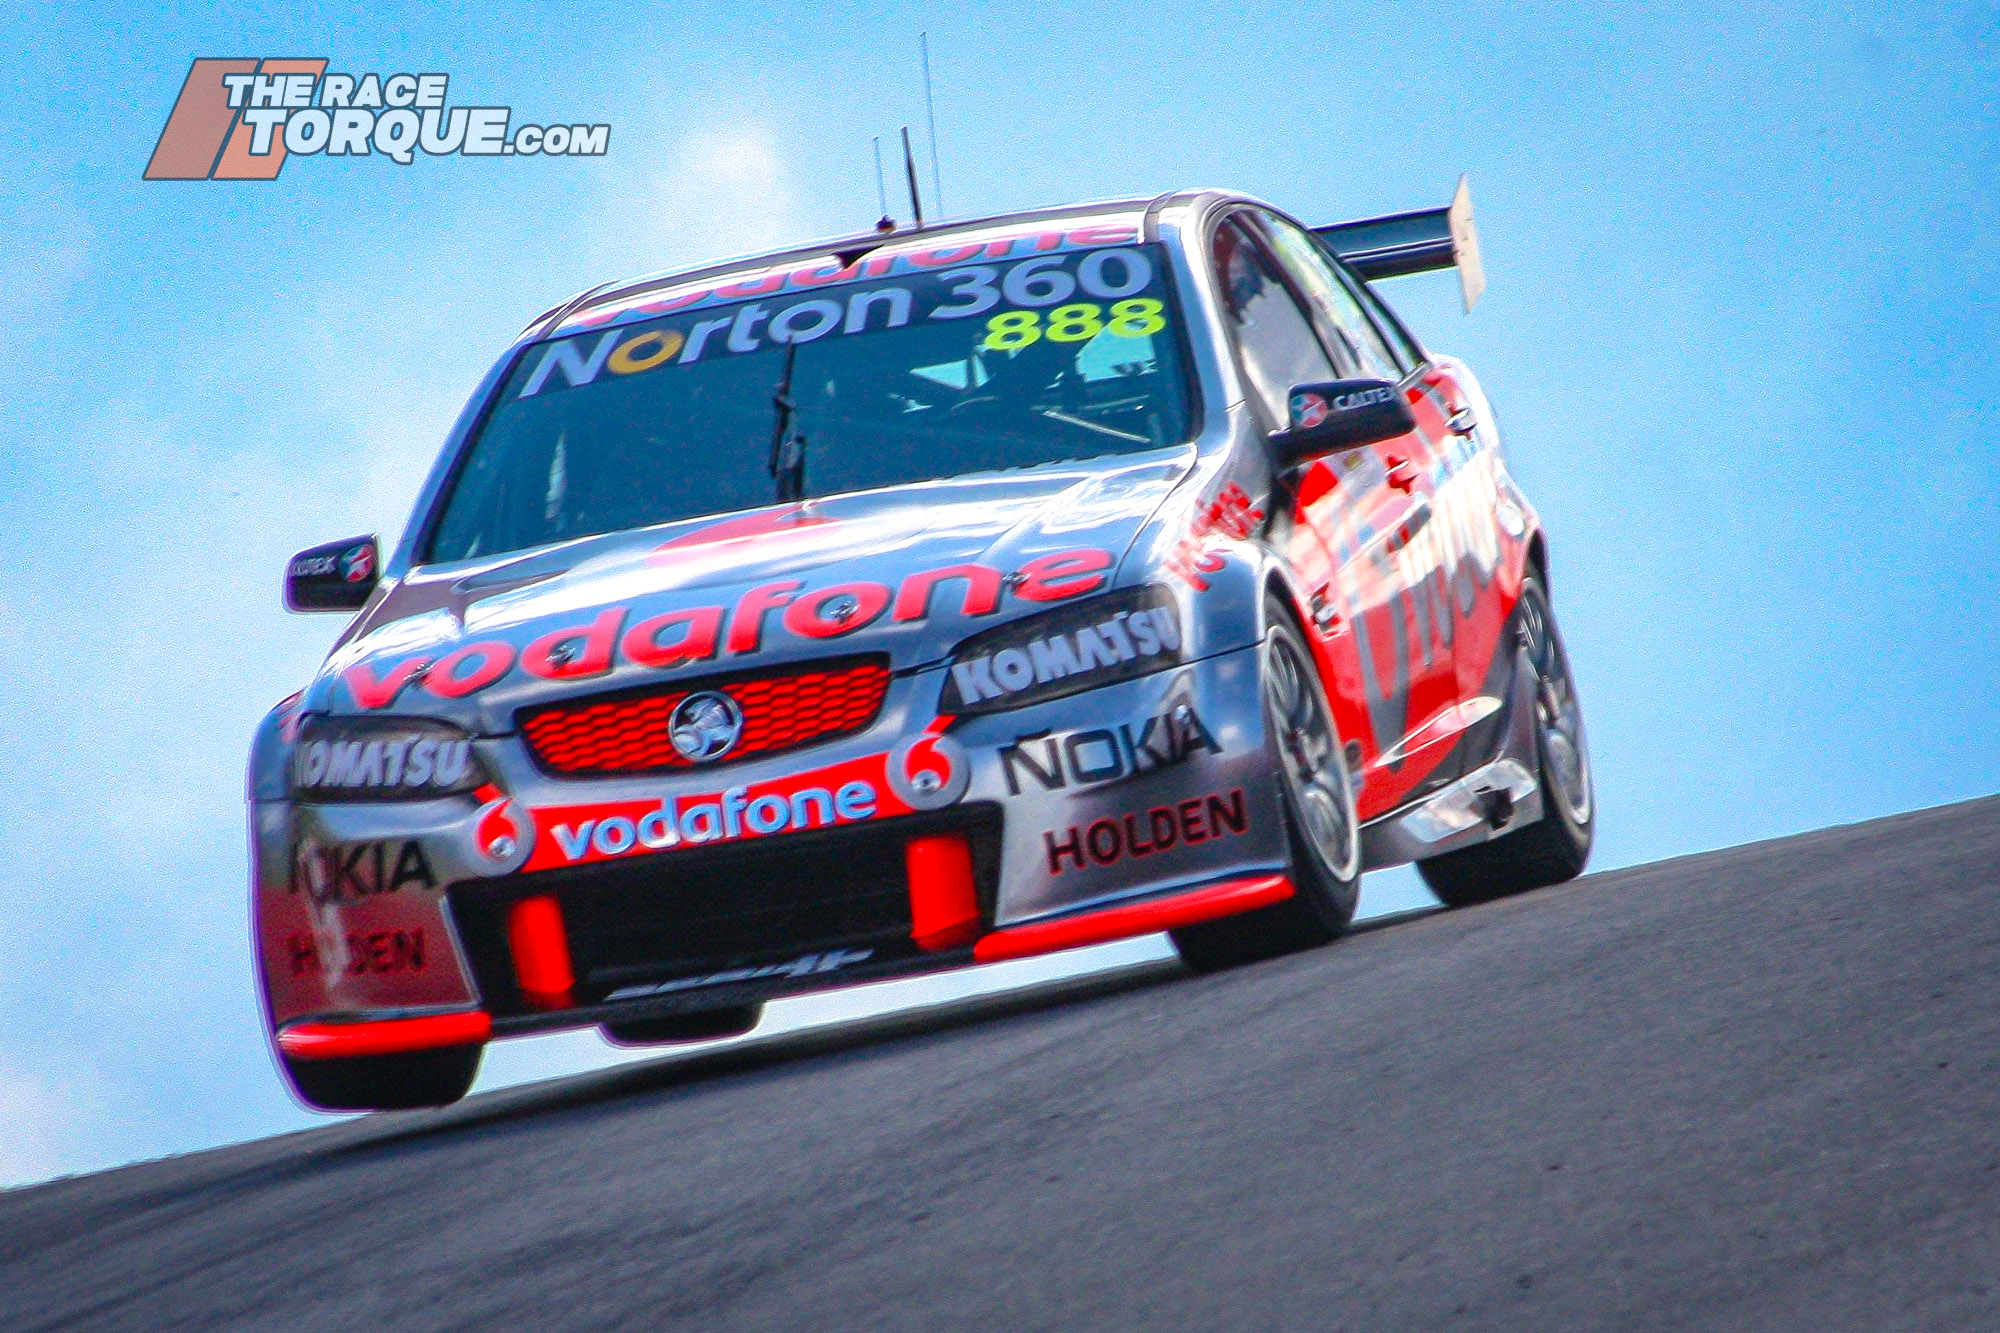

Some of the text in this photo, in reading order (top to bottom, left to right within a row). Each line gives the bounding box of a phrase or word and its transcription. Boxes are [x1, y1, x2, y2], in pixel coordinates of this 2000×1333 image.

[518, 247, 1152, 399] Norton 360
[984, 297, 1166, 351] 888
[343, 548, 1115, 709] vodafone
[952, 606, 1183, 706] KOMATSU
[996, 706, 1223, 797] NOKIA
[551, 778, 877, 861] vodafone
[1043, 788, 1249, 875] HOLDEN
